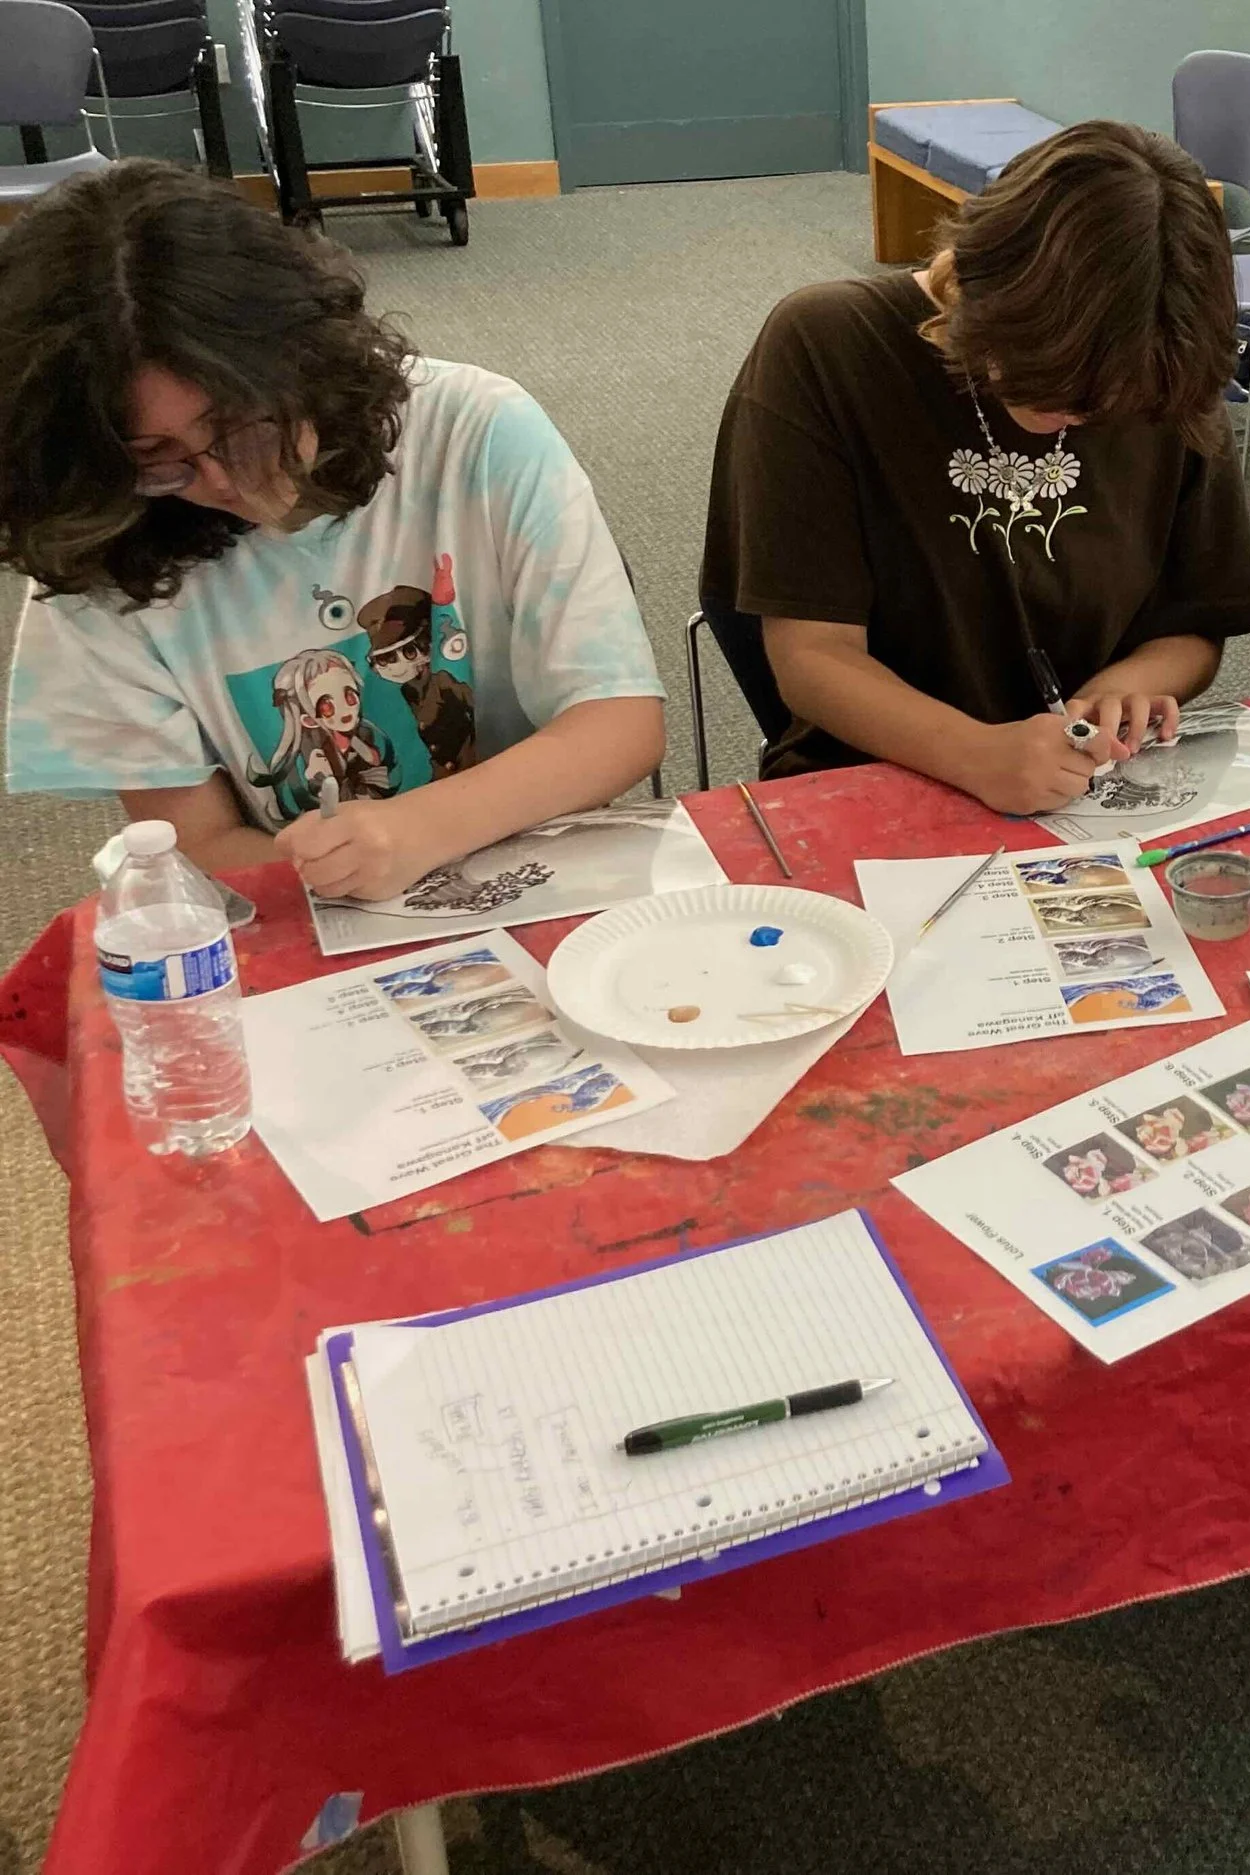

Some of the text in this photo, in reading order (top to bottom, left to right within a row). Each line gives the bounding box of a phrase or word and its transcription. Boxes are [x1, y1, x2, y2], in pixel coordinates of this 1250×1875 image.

[987, 880, 1014, 888] Step
[1007, 934, 1036, 942] Step
[1022, 977, 1052, 985] Step
[967, 1019, 1069, 1037] The Great Wave
[977, 1015, 1044, 1028] Kanagawa
[1173, 1069, 1196, 1087] Step
[431, 1097, 464, 1110] Step
[1098, 1105, 1120, 1124] Step
[396, 1141, 472, 1169] Kanagawa
[1021, 1141, 1044, 1160] Step
[389, 1140, 503, 1182] The Great Wave
[1193, 1178, 1217, 1197] Step
[1112, 1216, 1136, 1235] Step
[965, 1212, 1024, 1261] Lotus Flower
